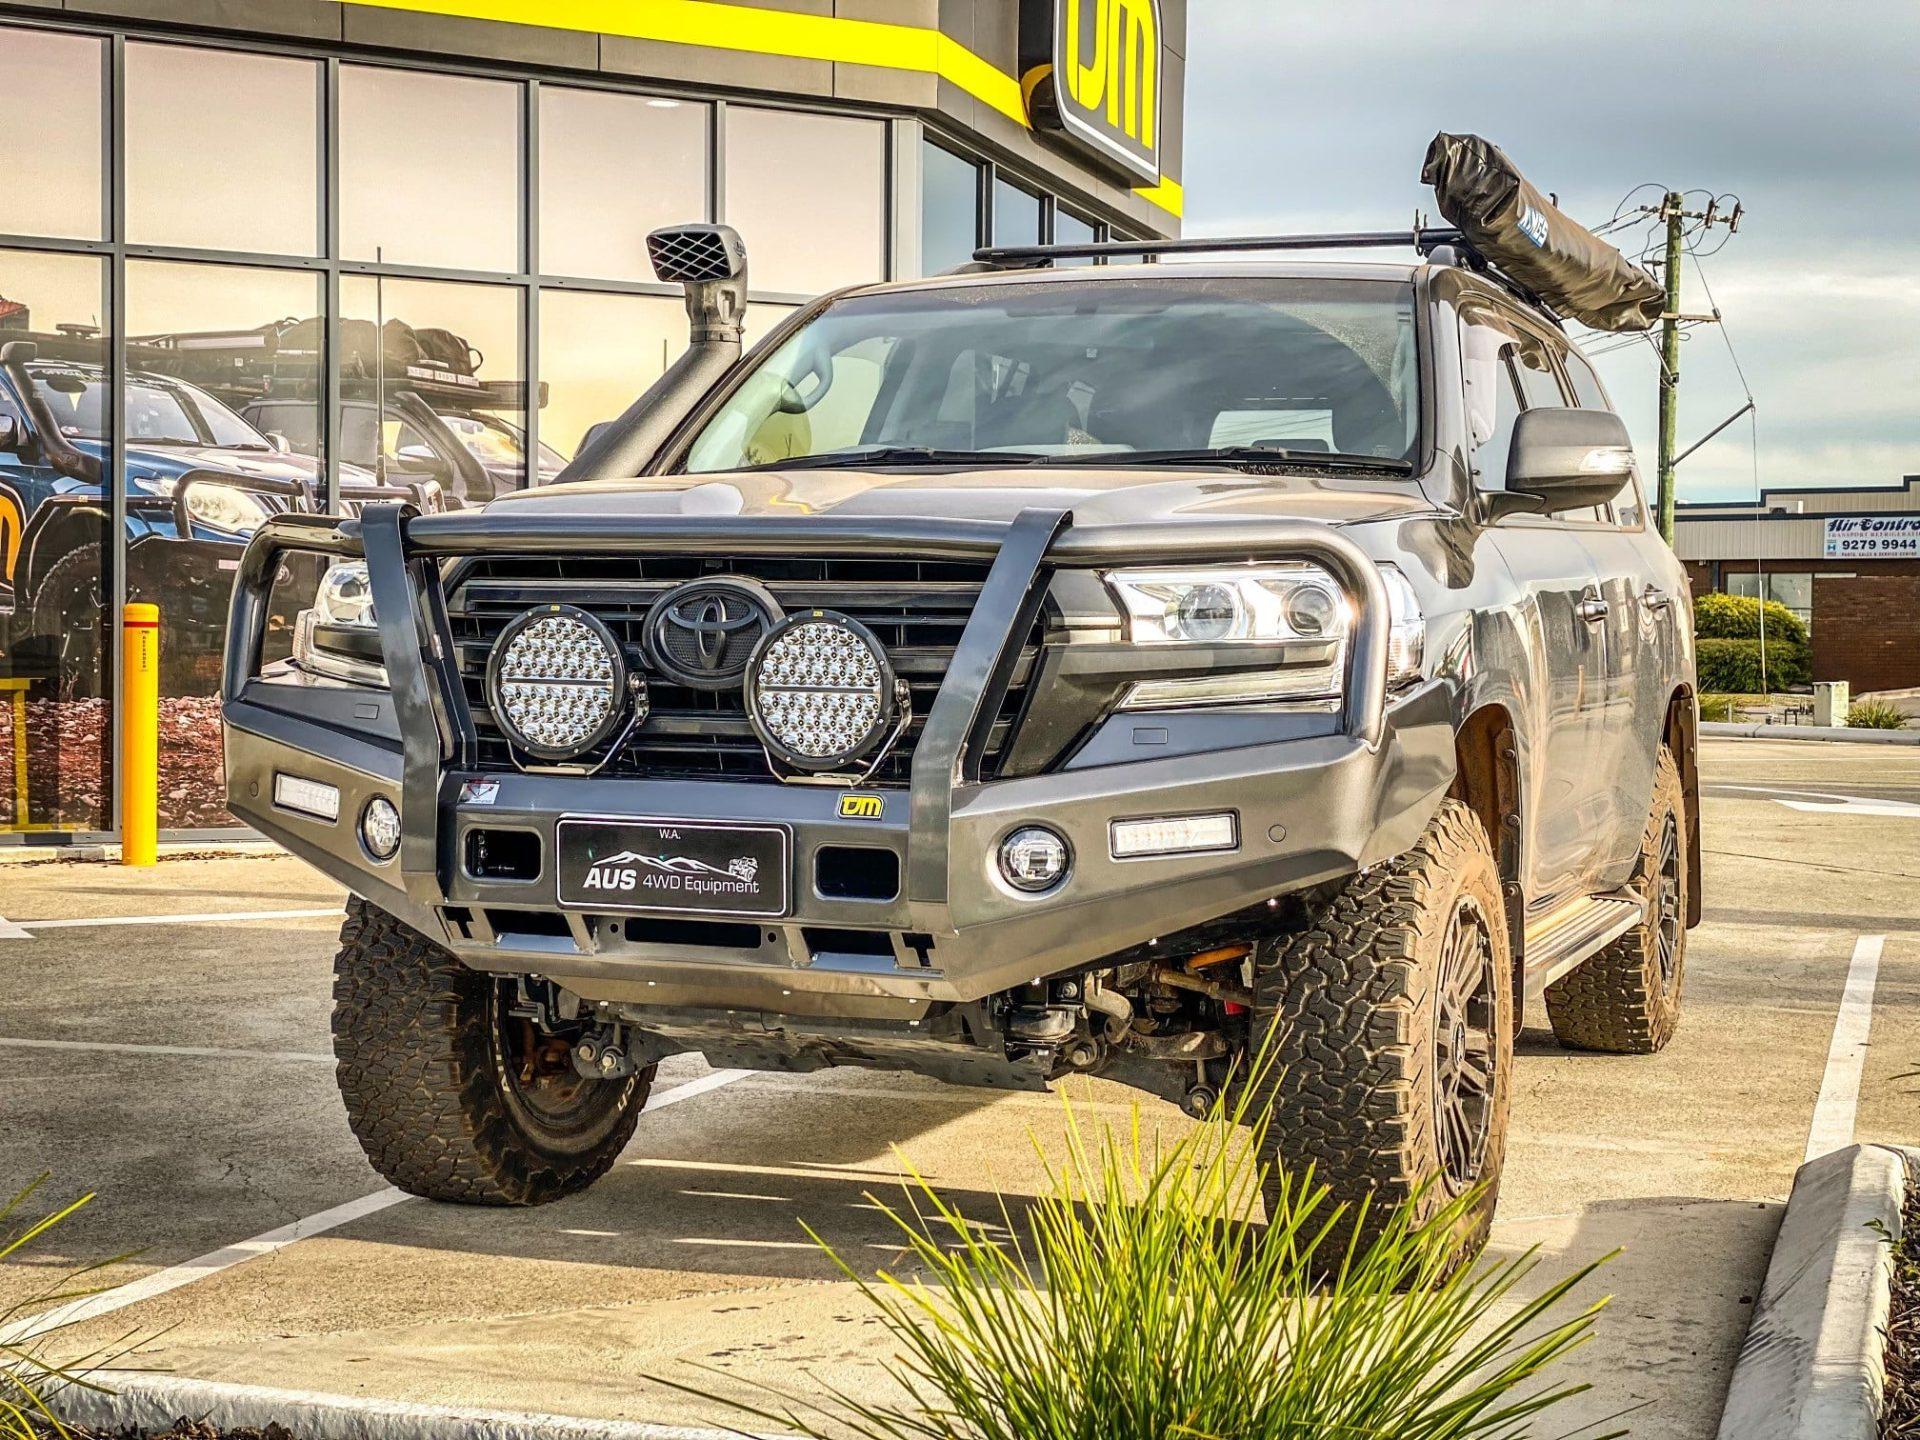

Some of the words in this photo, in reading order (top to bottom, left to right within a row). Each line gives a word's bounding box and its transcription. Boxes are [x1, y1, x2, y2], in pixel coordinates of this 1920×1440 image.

[1842, 540, 1876, 550] 9279
[1881, 539, 1917, 549] 9944
[583, 867, 637, 890] AUS
[642, 874, 681, 890] 4WD
[685, 875, 760, 895] Equipment
